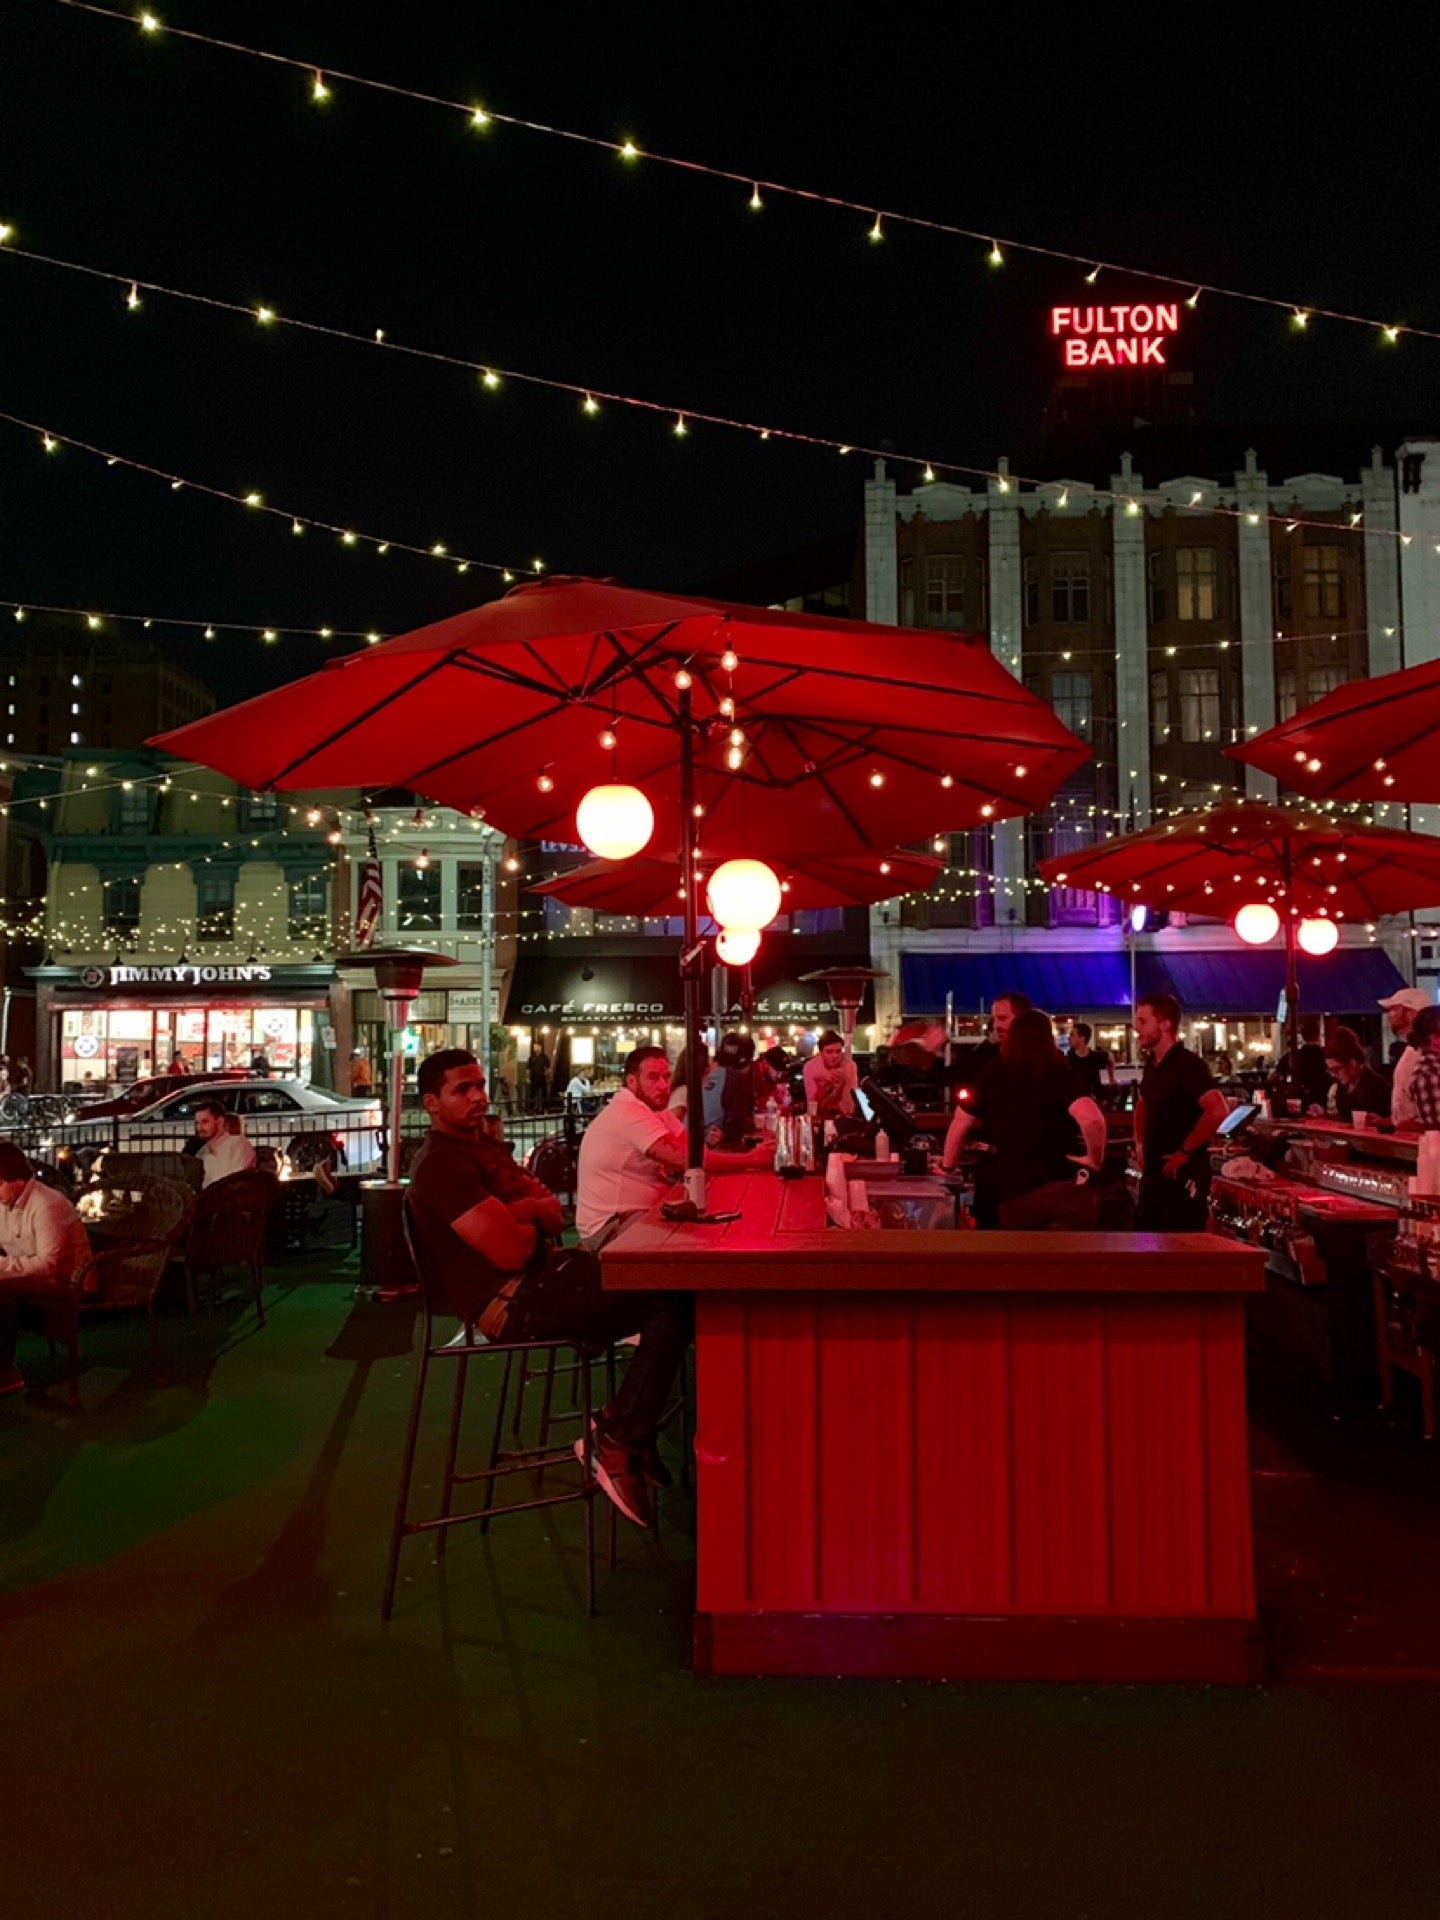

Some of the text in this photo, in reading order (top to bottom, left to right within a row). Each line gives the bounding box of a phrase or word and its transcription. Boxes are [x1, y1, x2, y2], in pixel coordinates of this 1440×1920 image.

[1051, 303, 1179, 335] FULTON
[1065, 336, 1166, 367] BANK
[110, 966, 185, 986] JIMMY
[187, 966, 272, 986] JOHN'S
[521, 1000, 664, 1014] CAFÉ FRESCO
[778, 1002, 832, 1012] FRES
